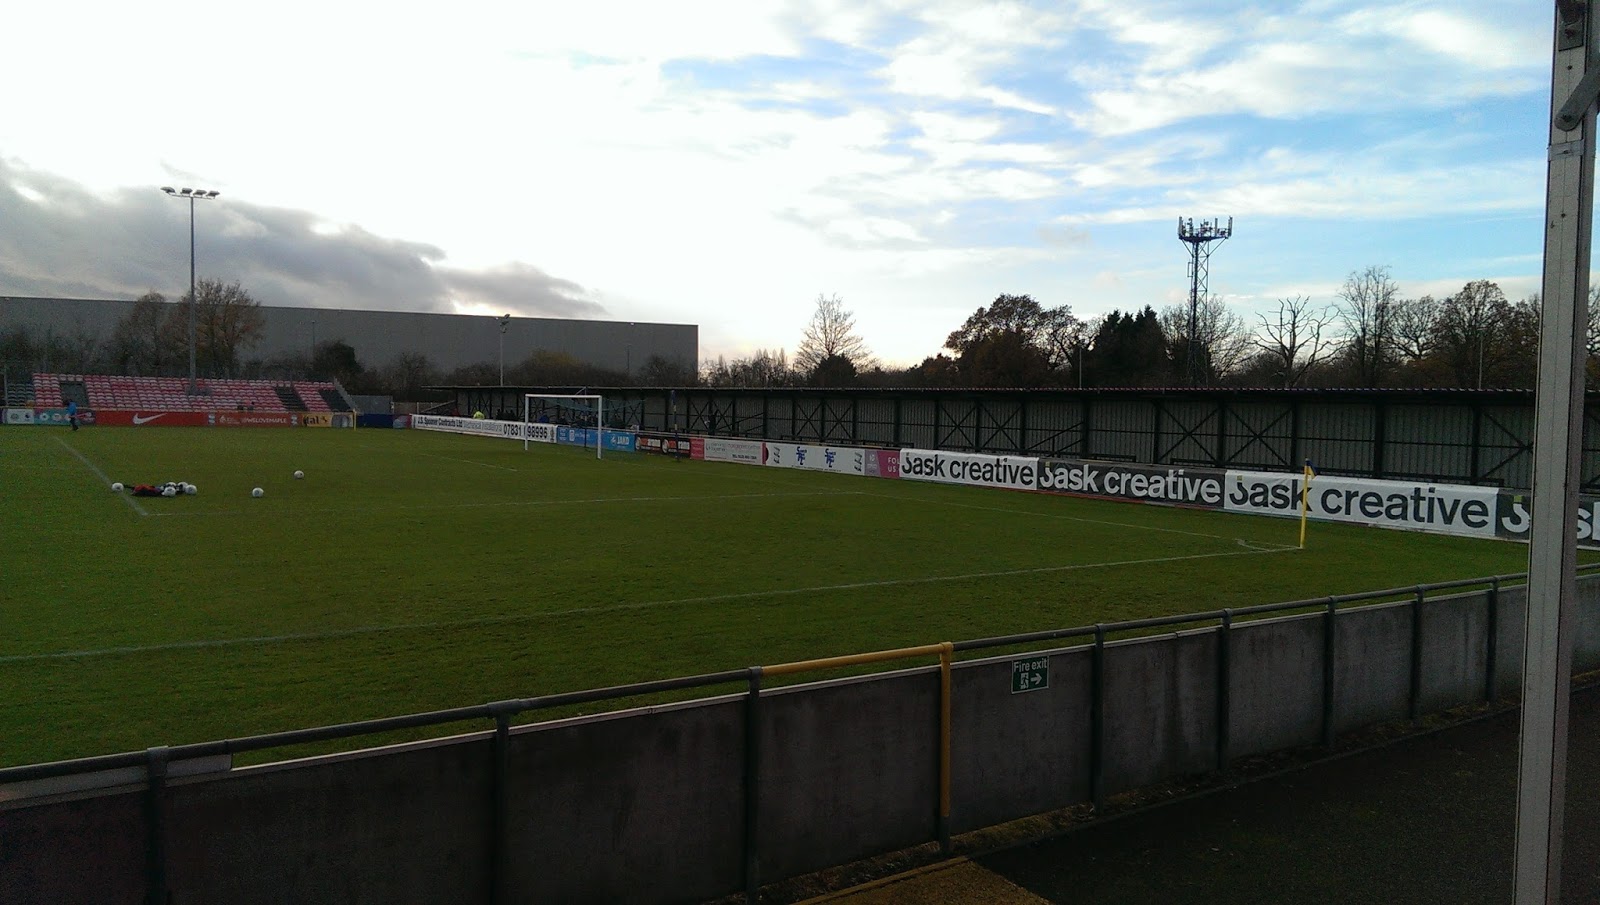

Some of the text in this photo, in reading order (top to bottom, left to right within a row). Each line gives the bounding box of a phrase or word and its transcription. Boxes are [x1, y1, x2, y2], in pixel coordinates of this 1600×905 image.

[503, 423, 521, 436] 07831
[887, 456, 900, 465] FOL
[887, 465, 897, 473] US
[949, 457, 1034, 486] creative
[1104, 469, 1221, 502] creative
[1320, 487, 1489, 528] creative
[1013, 657, 1047, 672] Fire exit
